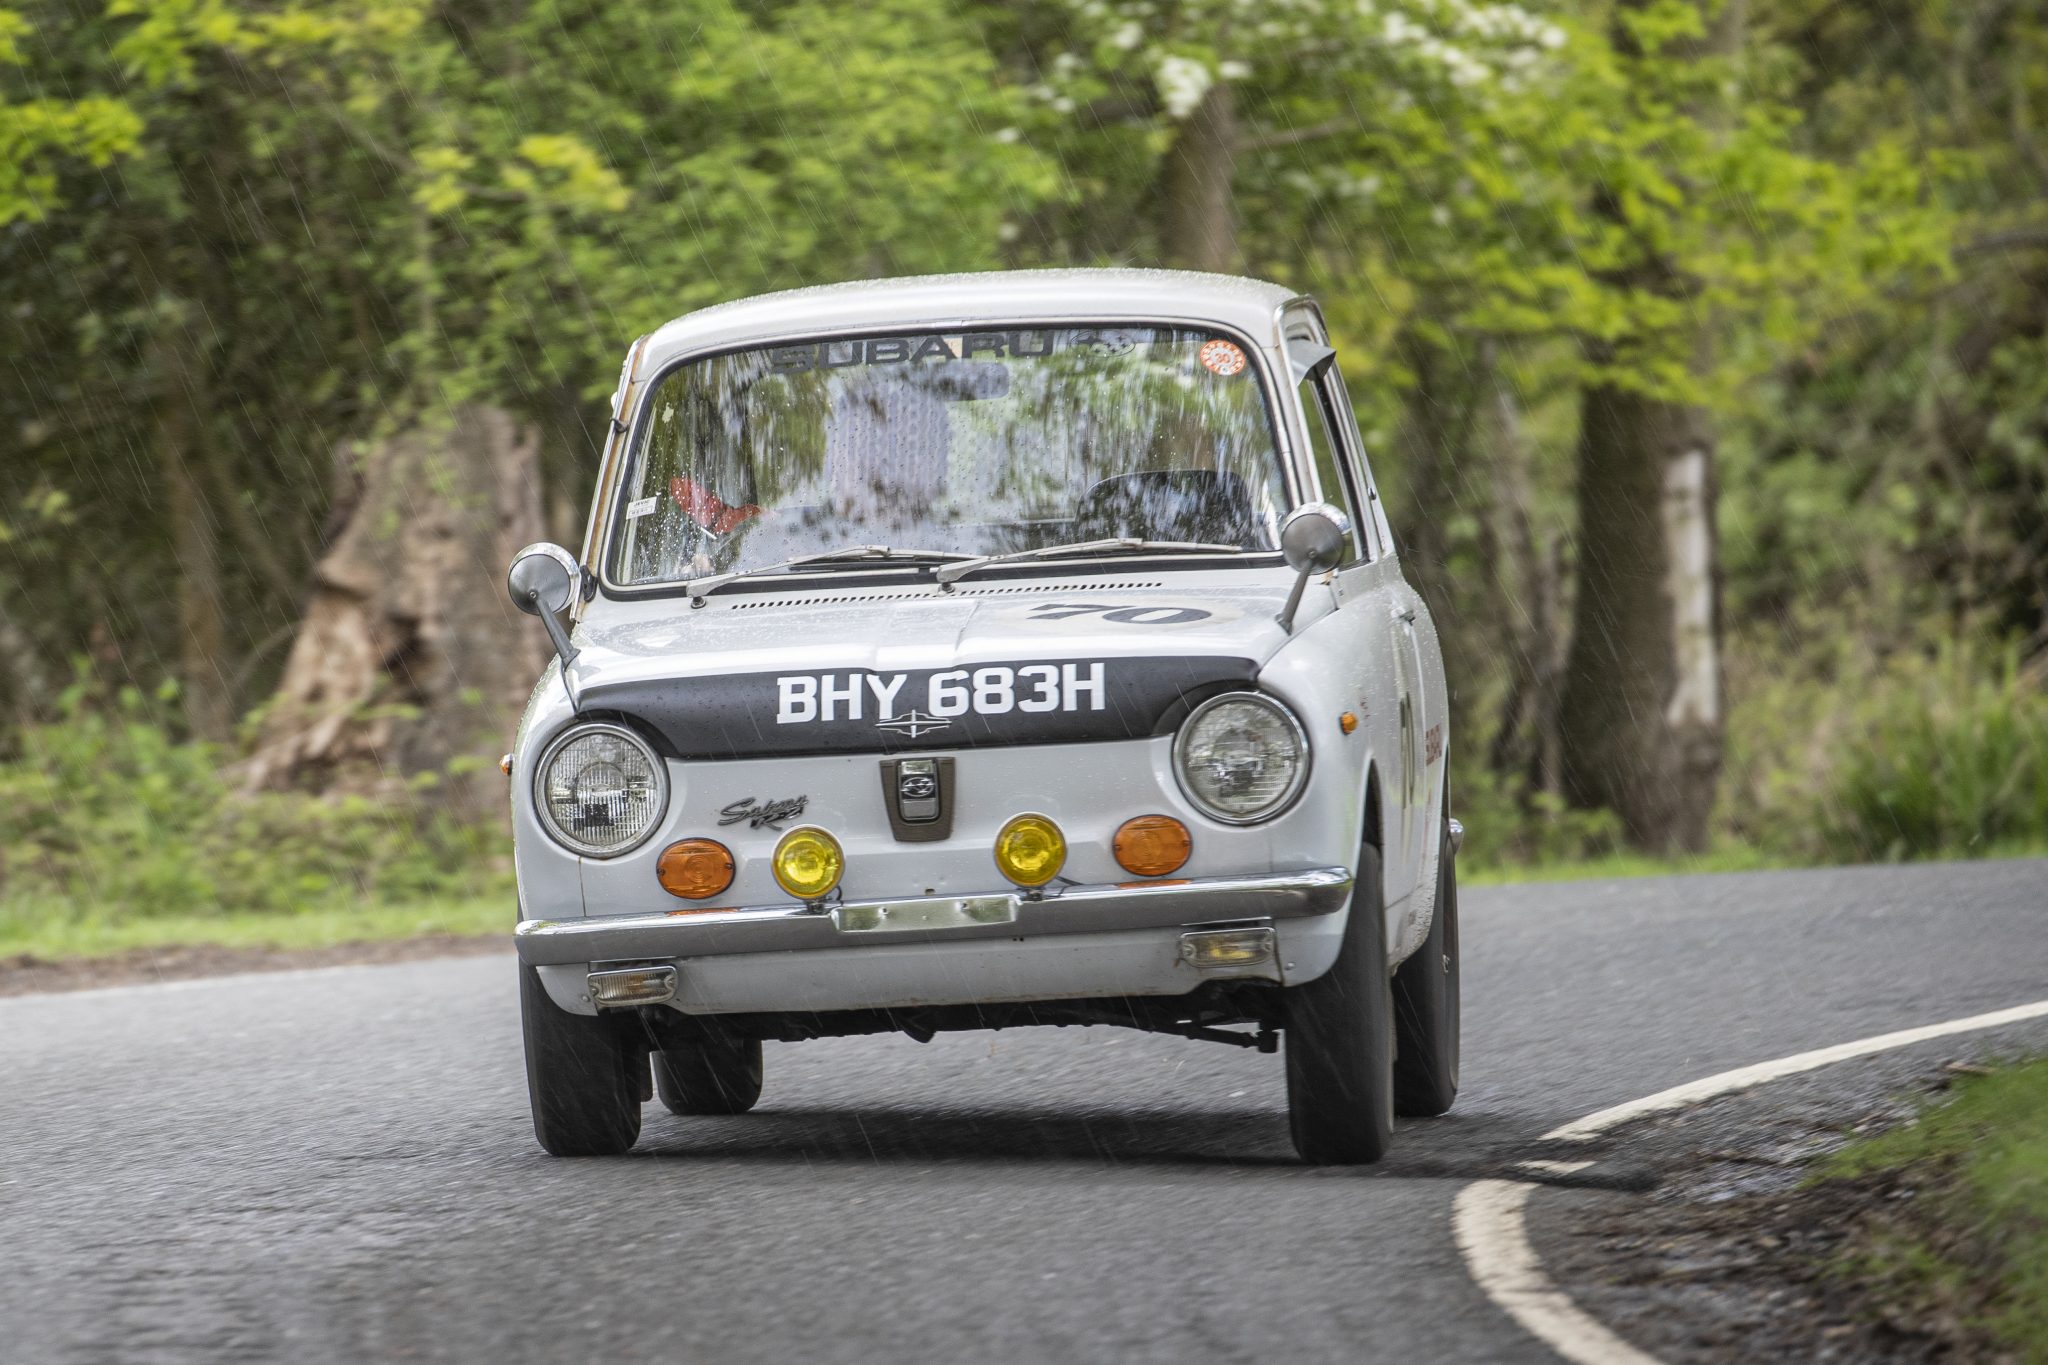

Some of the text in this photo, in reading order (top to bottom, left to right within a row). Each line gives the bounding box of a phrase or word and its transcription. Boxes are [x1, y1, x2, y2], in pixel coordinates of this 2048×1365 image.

[771, 330, 1054, 373] SUBARU
[1025, 603, 1213, 625] 70
[776, 662, 1106, 725] BHY 683H
